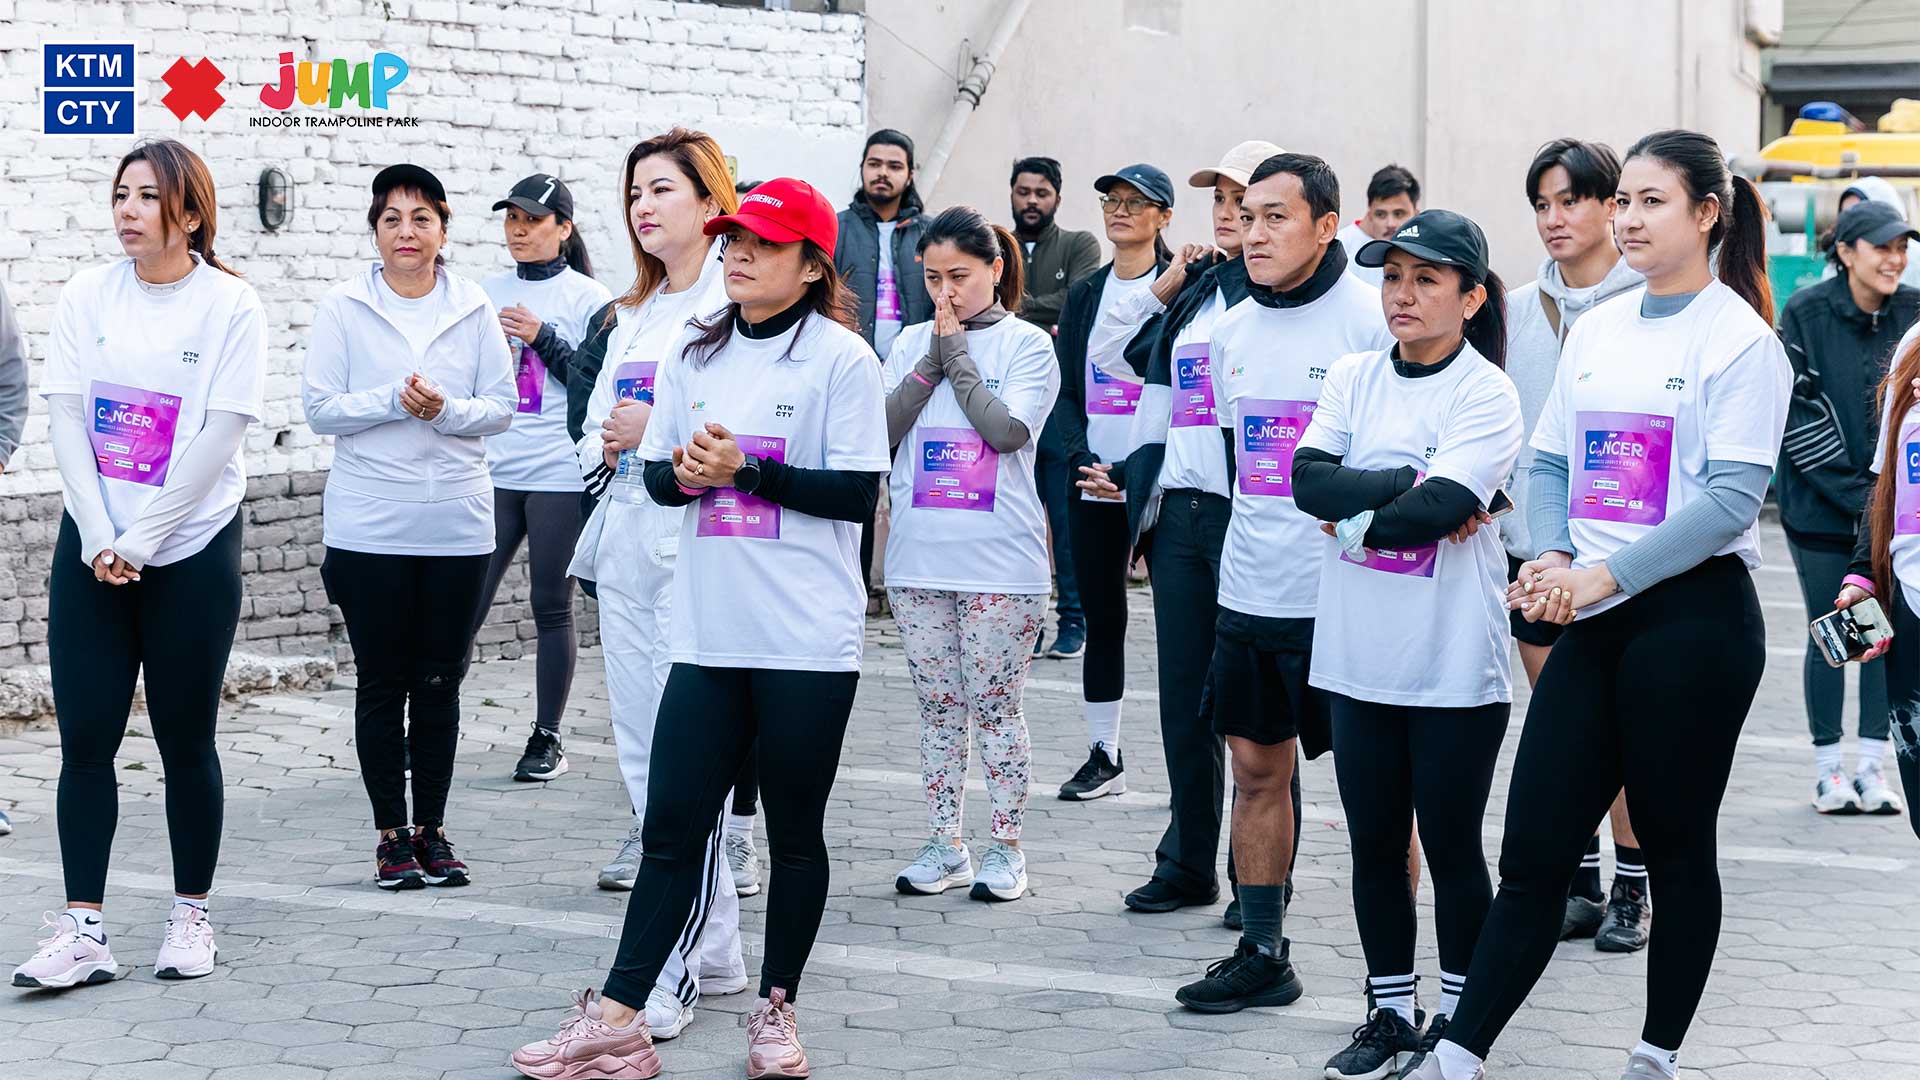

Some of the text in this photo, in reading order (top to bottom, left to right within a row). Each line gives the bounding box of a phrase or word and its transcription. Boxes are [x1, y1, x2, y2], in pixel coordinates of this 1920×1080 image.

[1310, 366, 1327, 374] KTM
[1667, 377, 1685, 385] KTM
[1650, 419, 1666, 428] 083
[762, 440, 777, 449] 078
